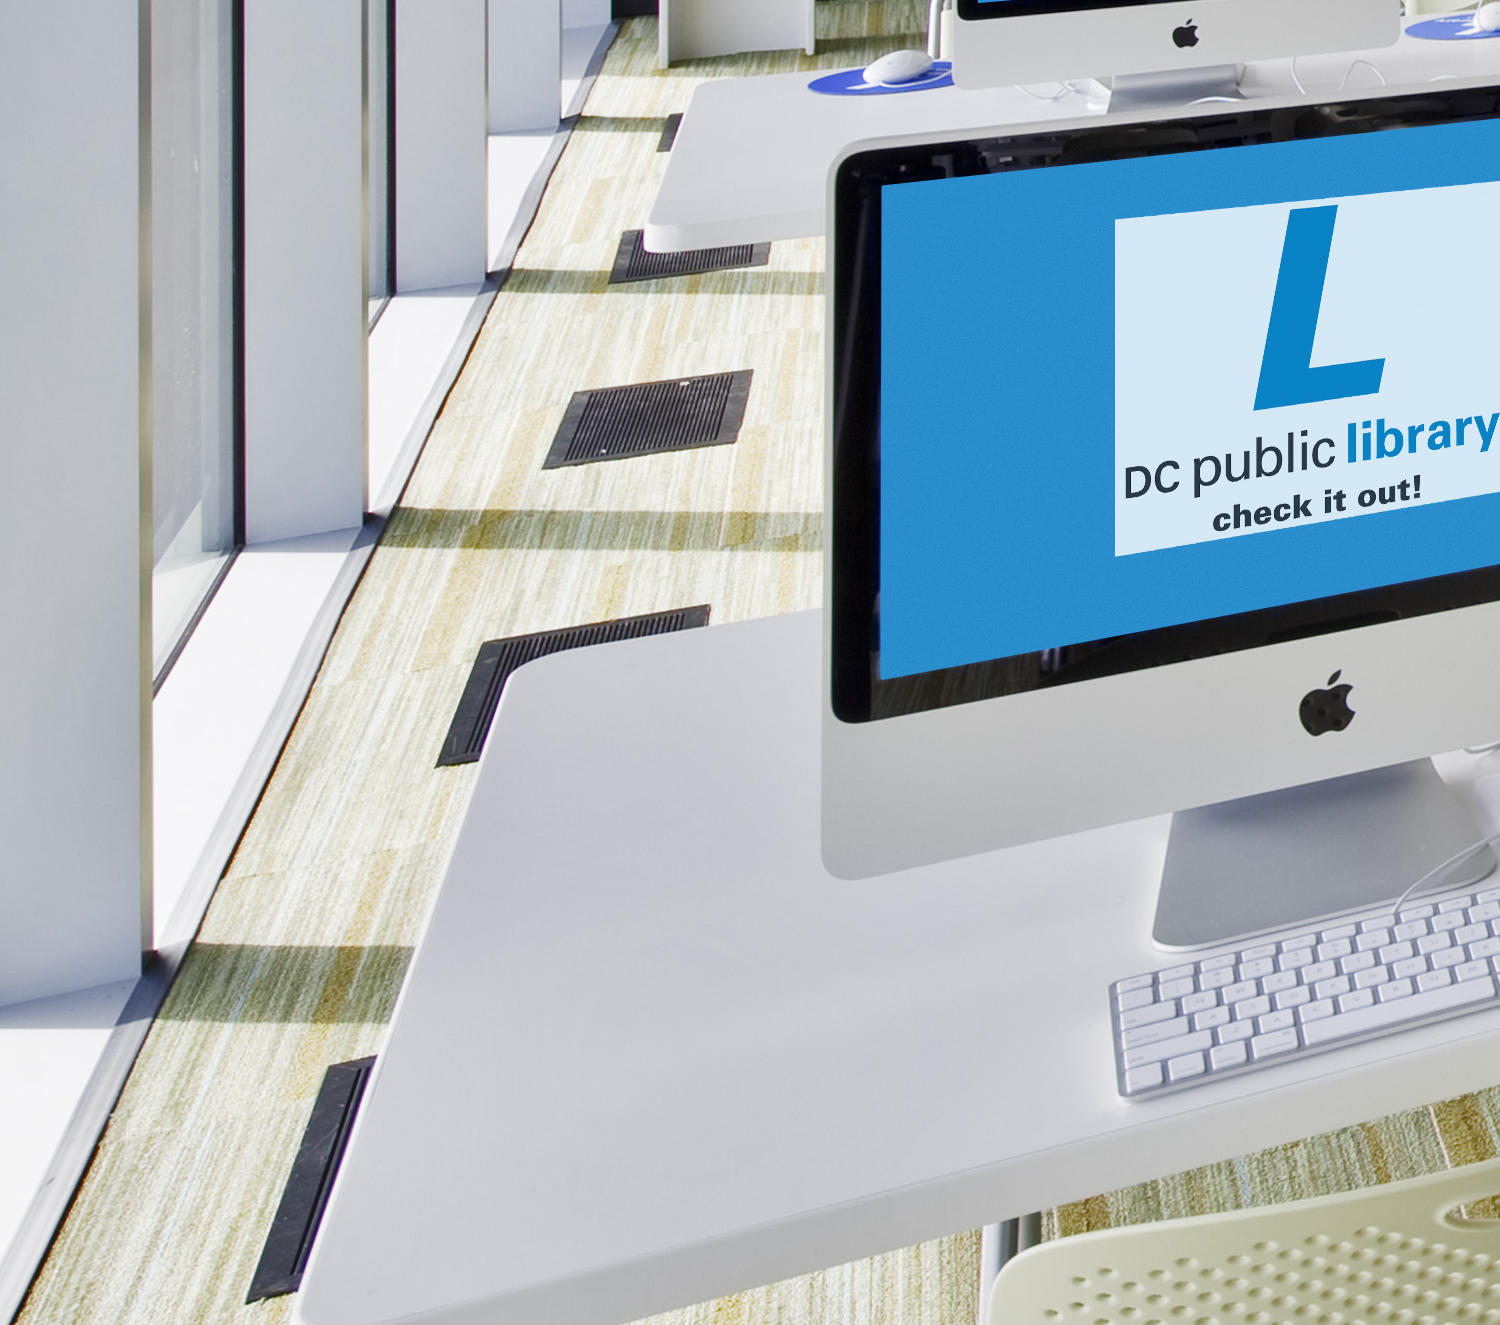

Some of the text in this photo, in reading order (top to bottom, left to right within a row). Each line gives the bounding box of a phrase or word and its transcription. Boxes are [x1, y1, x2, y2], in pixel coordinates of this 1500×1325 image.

[1253, 205, 1385, 411] L
[1125, 412, 1500, 499] DC public library
[1212, 475, 1423, 532] check it out!
